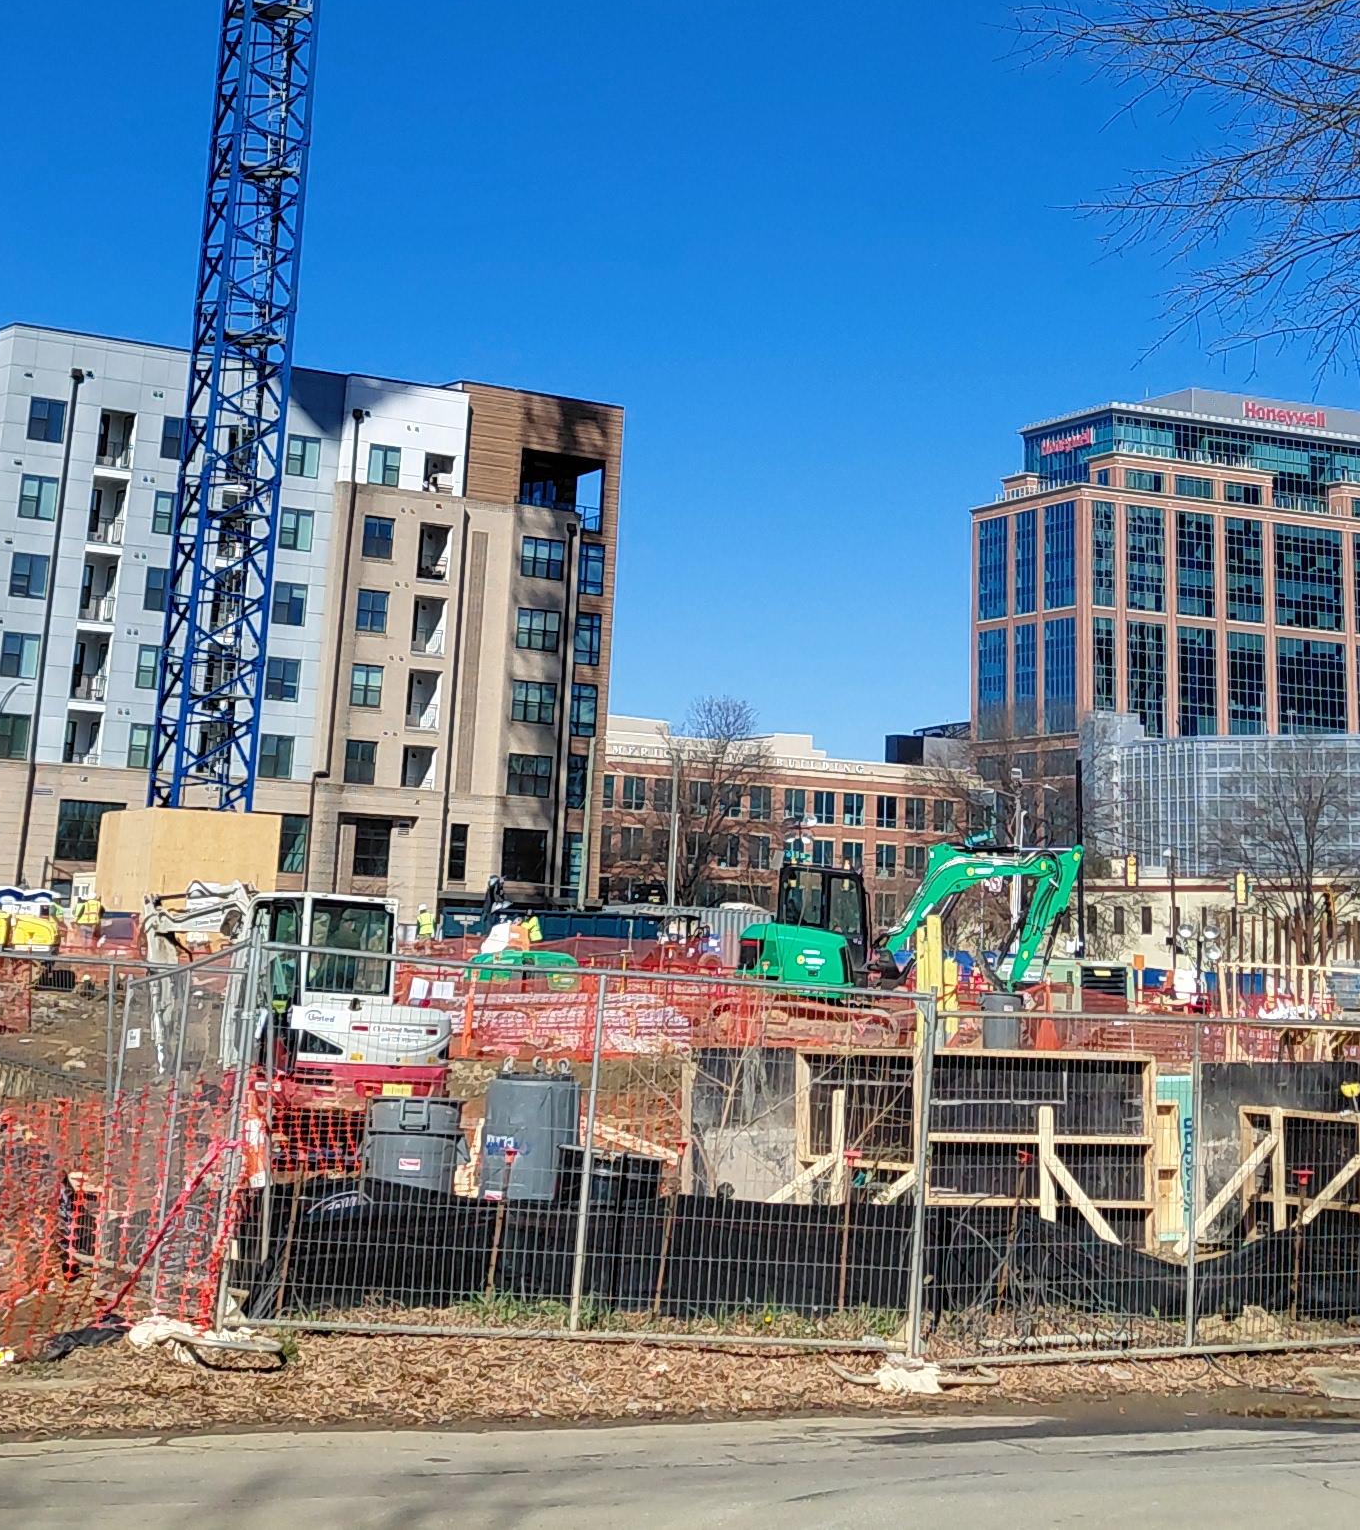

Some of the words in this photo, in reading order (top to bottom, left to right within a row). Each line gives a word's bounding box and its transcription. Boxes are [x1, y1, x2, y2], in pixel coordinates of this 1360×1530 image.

[1242, 401, 1325, 428] Honeywell
[1041, 427, 1092, 455] Honeywell
[307, 1011, 336, 1023] United
